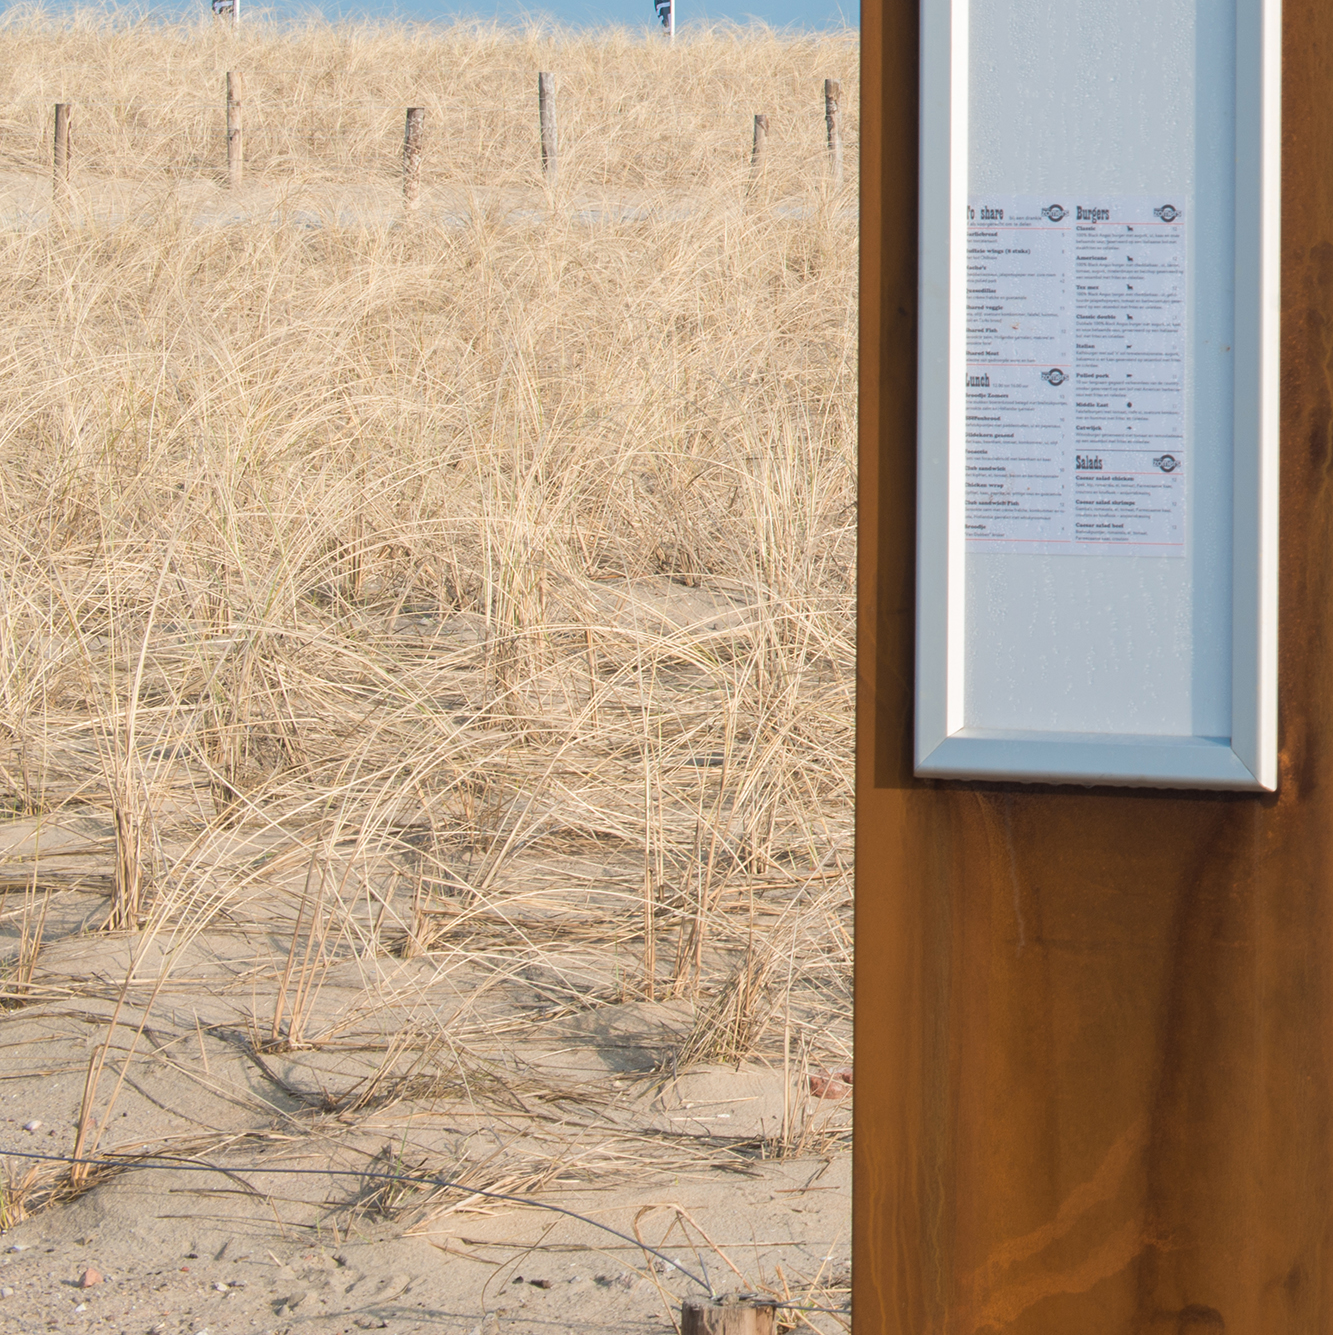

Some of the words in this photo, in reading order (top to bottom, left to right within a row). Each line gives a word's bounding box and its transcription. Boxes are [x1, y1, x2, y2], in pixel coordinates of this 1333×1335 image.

[981, 205, 1004, 220] share
[1076, 206, 1110, 223] Burgers
[966, 373, 990, 387] Lunch
[1076, 455, 1103, 469] Salads
